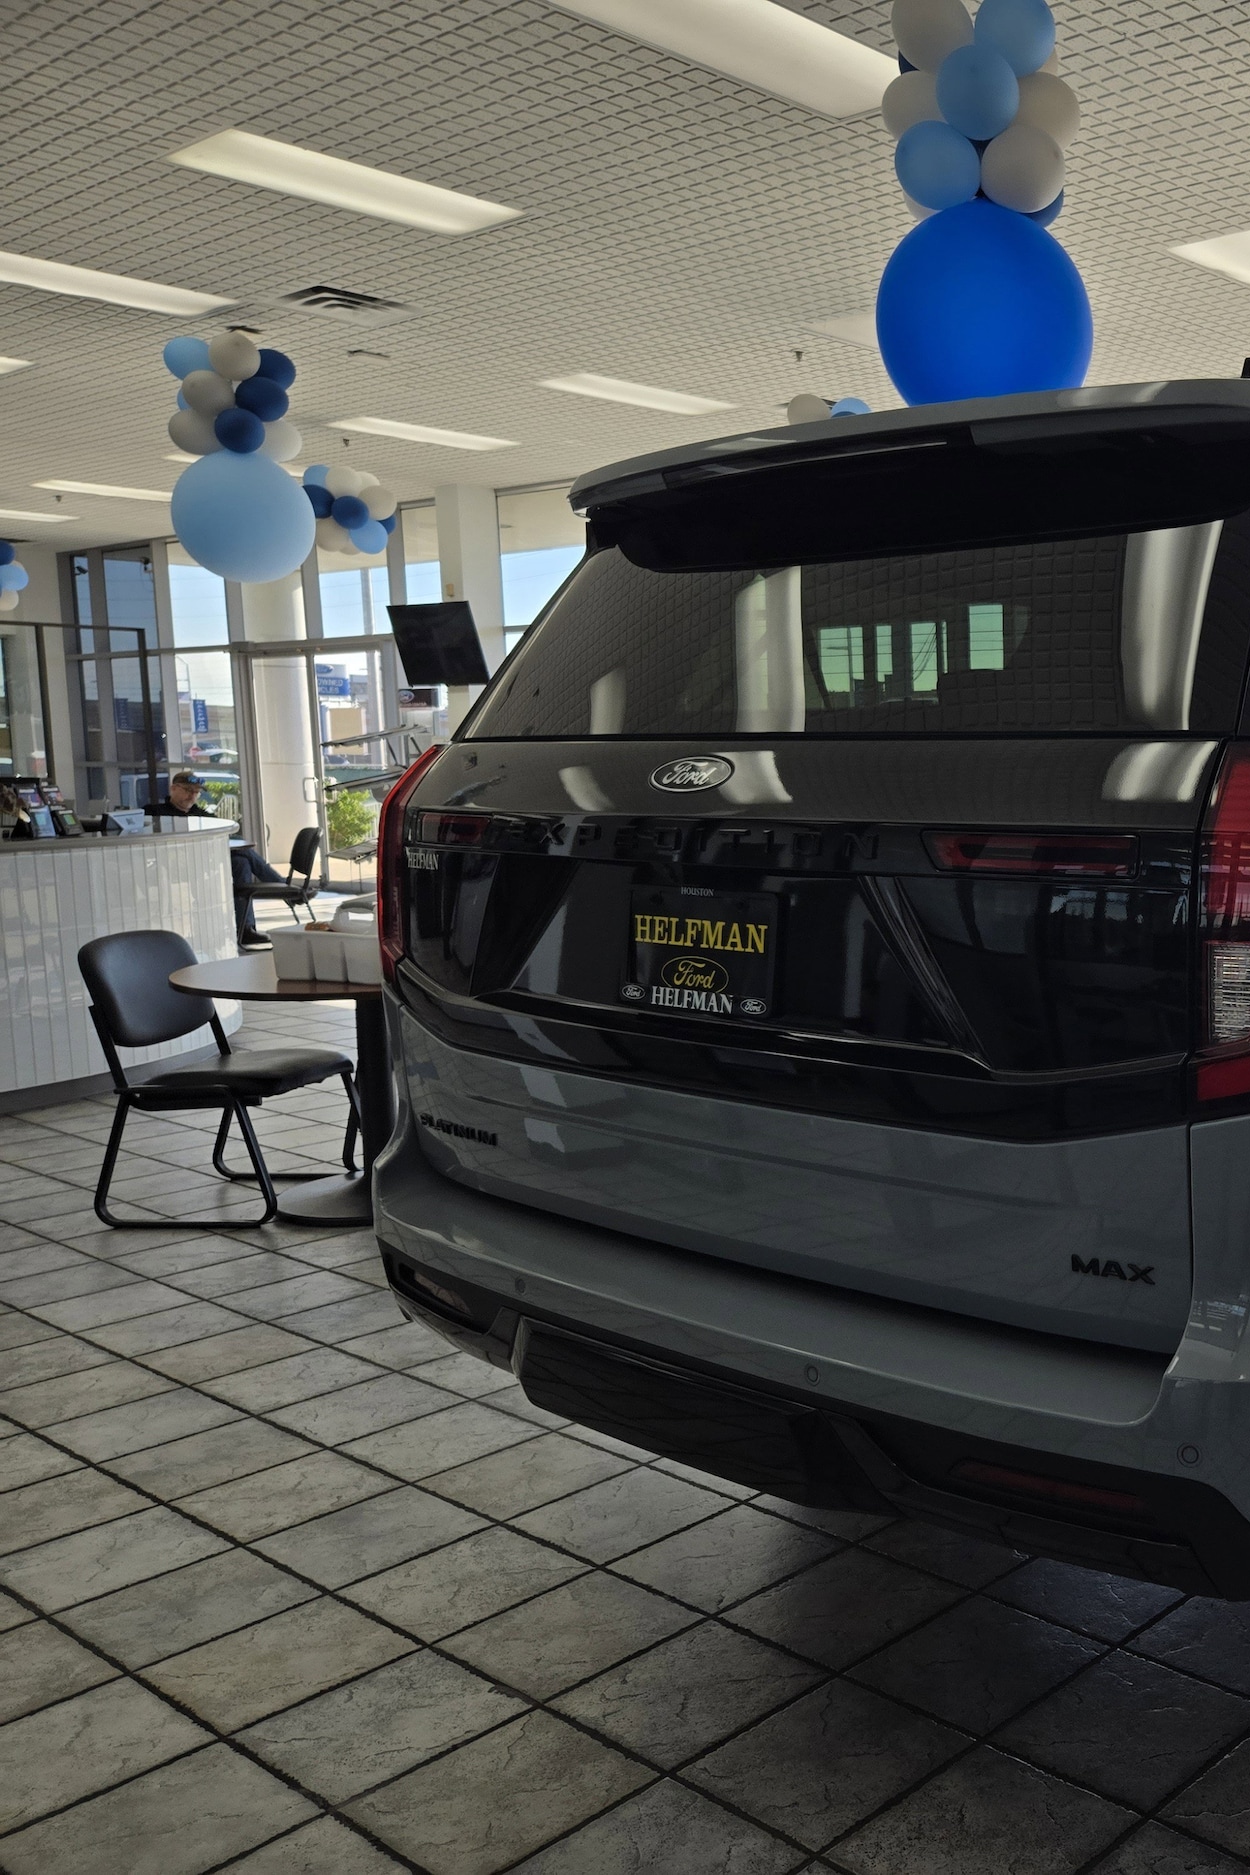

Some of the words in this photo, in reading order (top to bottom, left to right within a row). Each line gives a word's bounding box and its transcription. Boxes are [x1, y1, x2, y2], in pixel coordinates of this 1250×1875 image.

[660, 760, 719, 787] Ford
[507, 822, 880, 860] EXPEDITION
[680, 886, 715, 897] HOUSTON
[634, 914, 769, 954] HELFMAN
[673, 958, 717, 990] Ford
[650, 985, 734, 1014] HELFMAN
[1070, 1253, 1156, 1286] MAX
